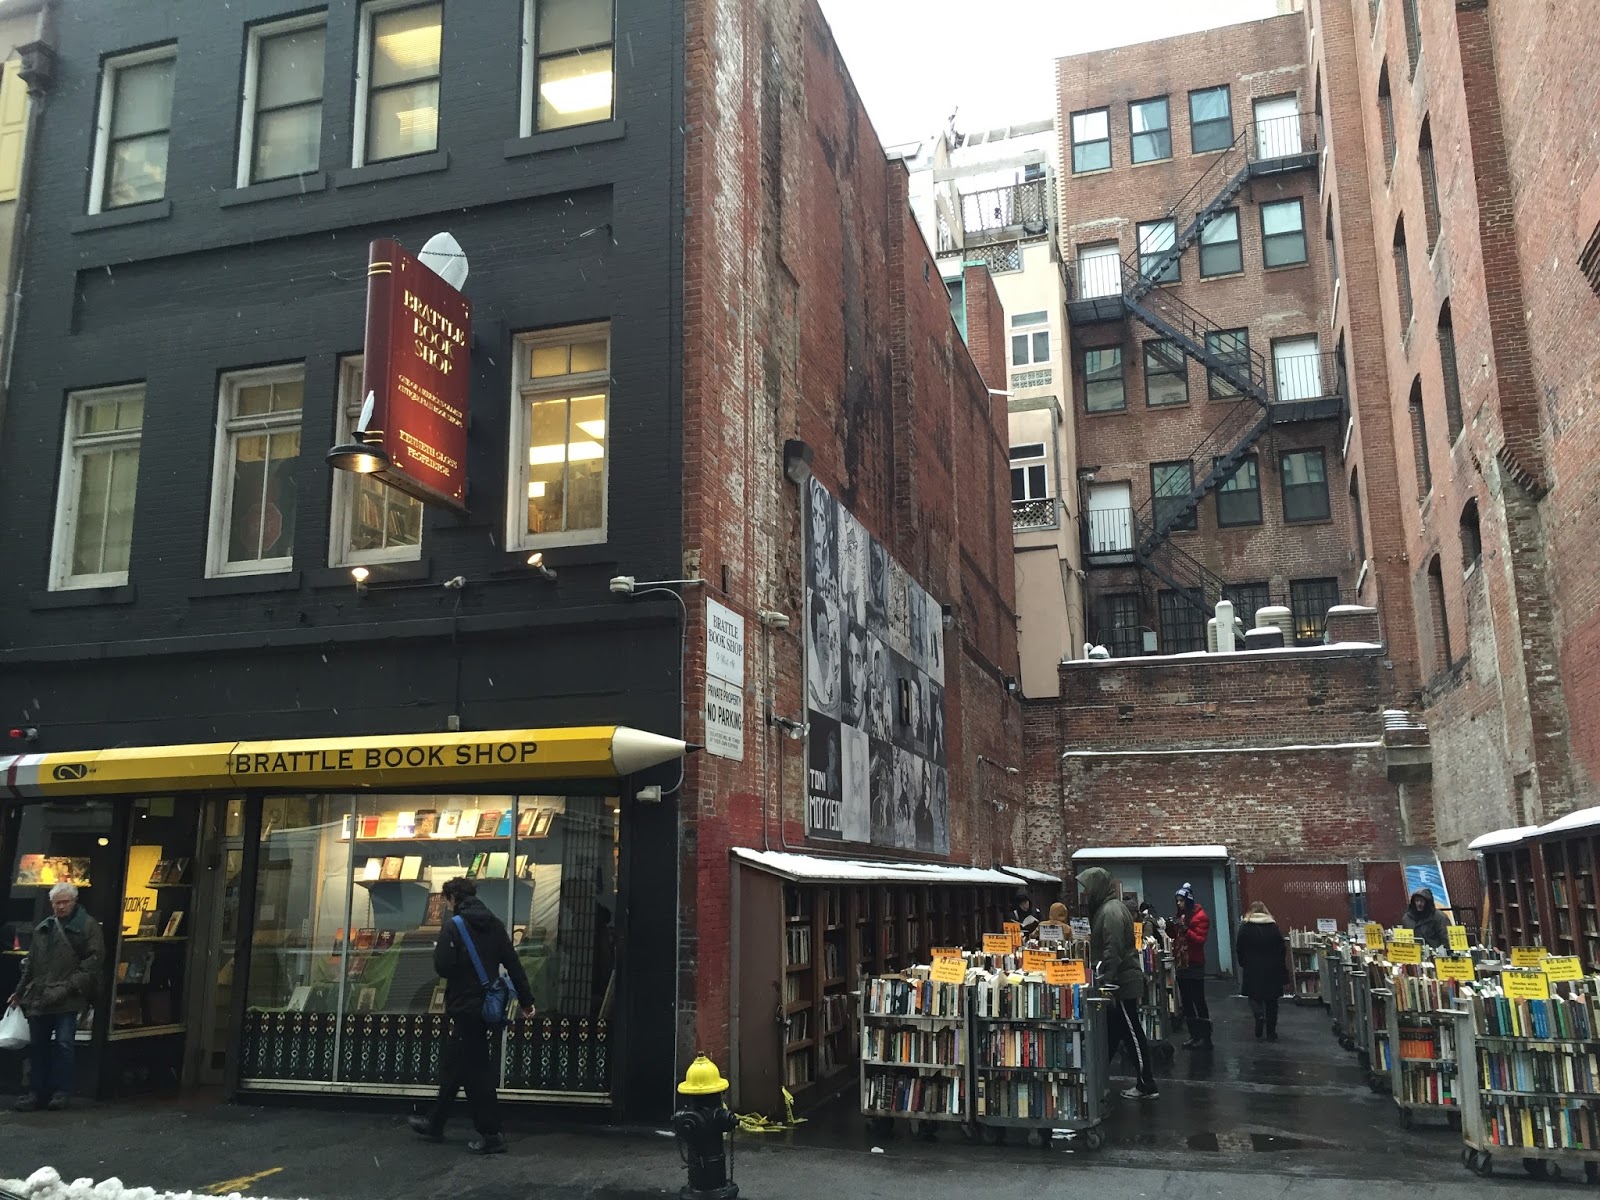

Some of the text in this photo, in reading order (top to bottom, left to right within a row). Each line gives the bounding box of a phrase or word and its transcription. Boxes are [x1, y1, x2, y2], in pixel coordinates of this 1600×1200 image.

[403, 288, 466, 347] BRATTLE
[413, 317, 455, 360] BOOK
[414, 339, 453, 376] SHOP
[713, 614, 739, 640] BRATTLE
[708, 628, 743, 657] BOOK SHOP
[708, 684, 742, 707] PRIVATE PROPERTY
[707, 702, 742, 731] NO PARKING
[235, 741, 538, 774] BRATTLE BOOK SHOP
[809, 768, 827, 792] TONI
